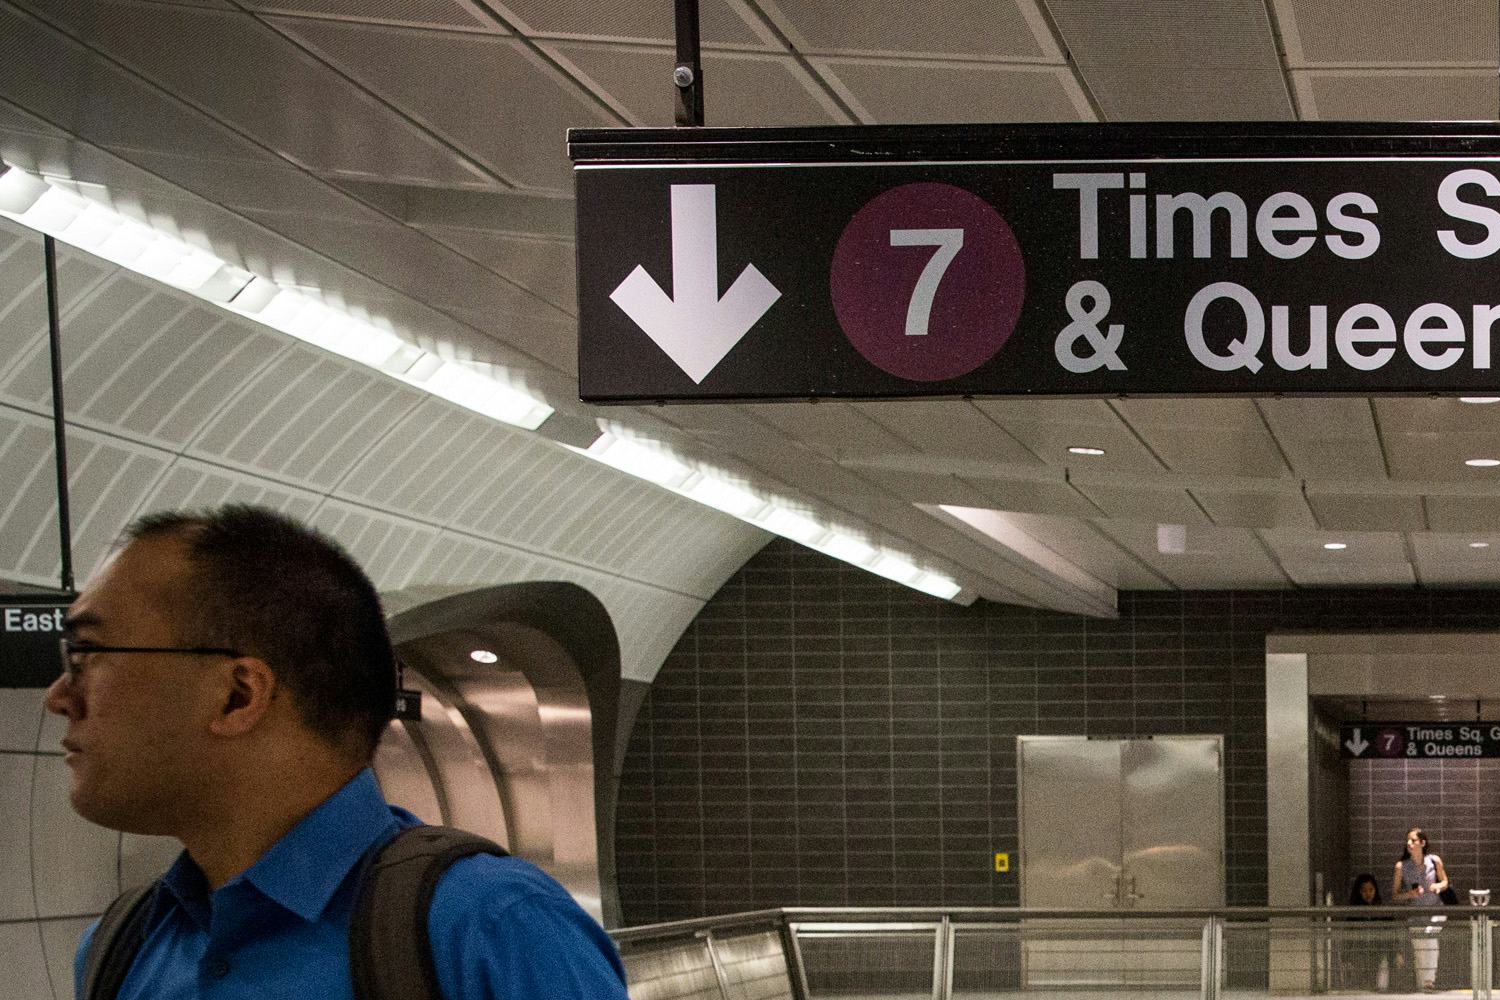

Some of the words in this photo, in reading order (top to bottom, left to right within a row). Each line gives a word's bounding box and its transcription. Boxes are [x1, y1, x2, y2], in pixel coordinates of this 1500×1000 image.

[1052, 171, 1381, 260] Times
[889, 228, 965, 336] 7
[1054, 280, 1129, 374] &
[4, 608, 64, 632] East
[1383, 734, 1395, 751] 7
[1406, 726, 1453, 740] Times
[1406, 742, 1417, 756] &
[1424, 742, 1482, 757] Queens
